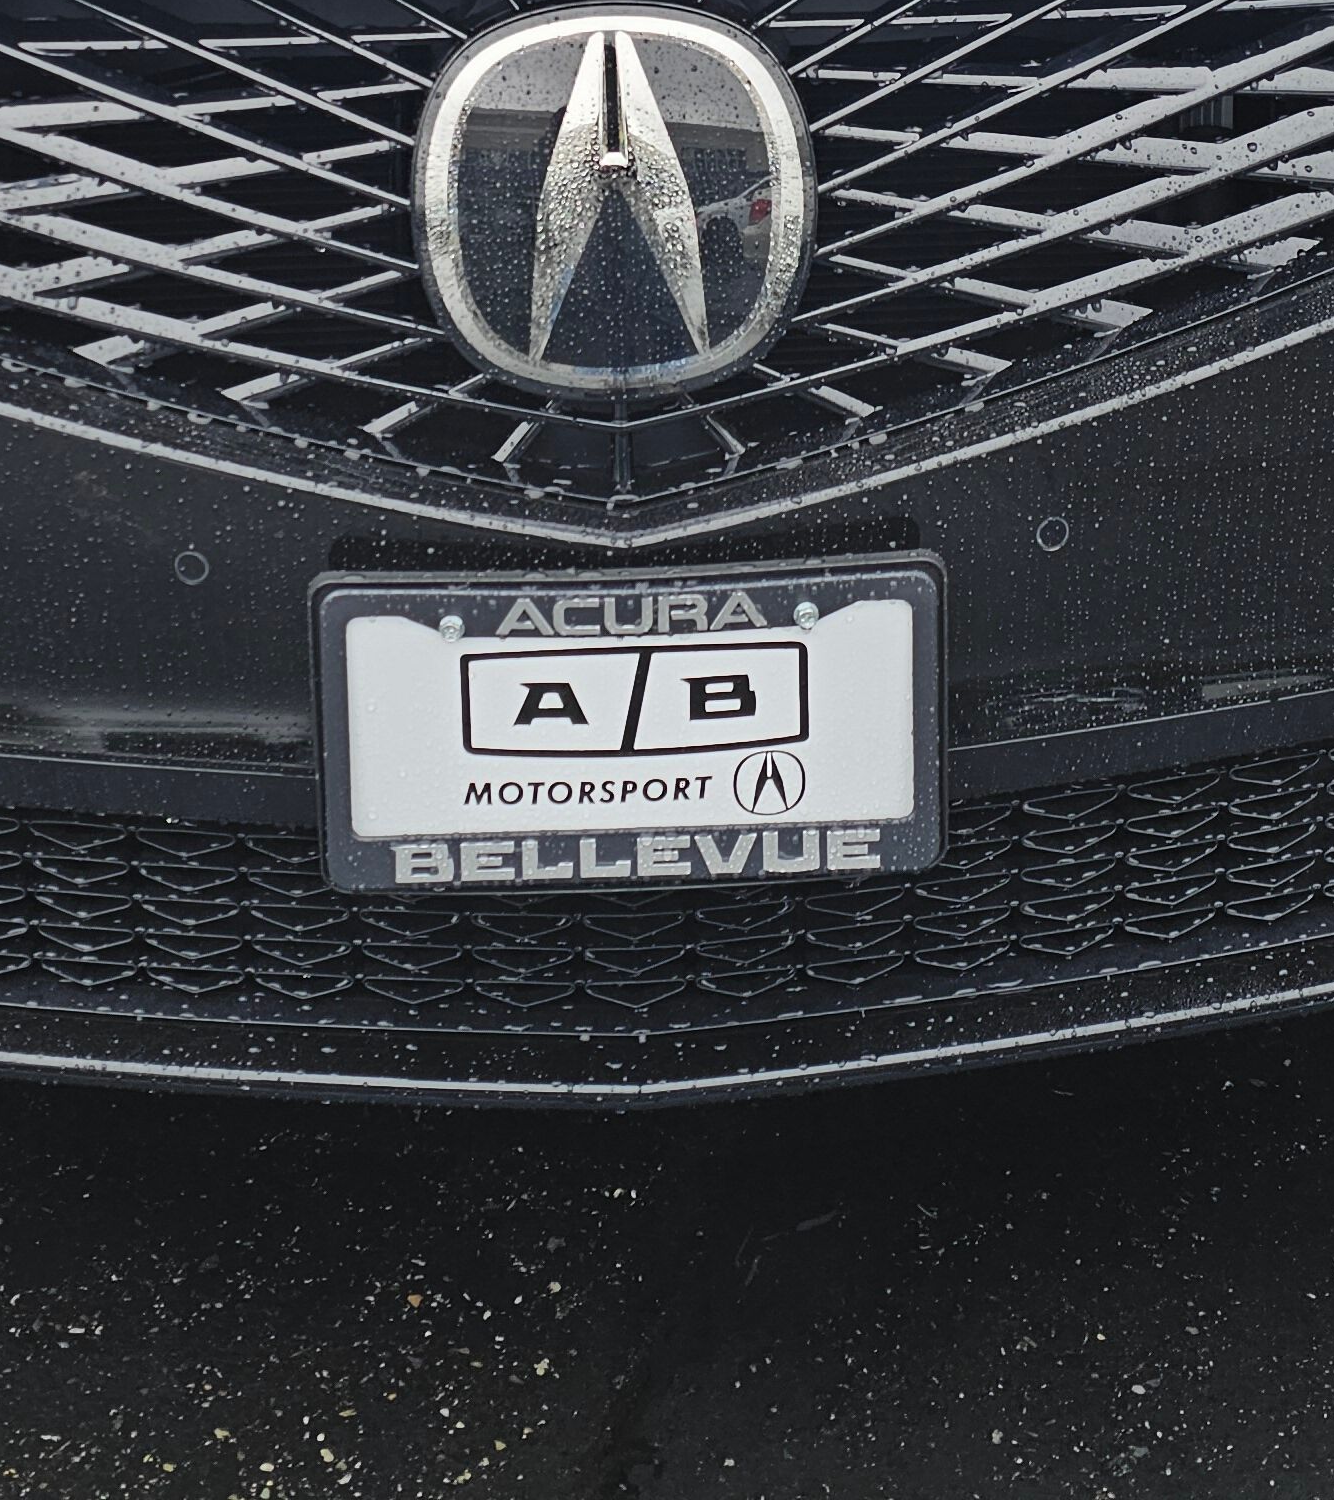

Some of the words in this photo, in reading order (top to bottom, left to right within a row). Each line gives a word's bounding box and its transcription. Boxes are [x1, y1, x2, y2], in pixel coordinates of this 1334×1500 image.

[495, 591, 768, 637] ACURA
[463, 774, 713, 806] MOTORSPORT
[390, 828, 882, 884] BELLEVUE
